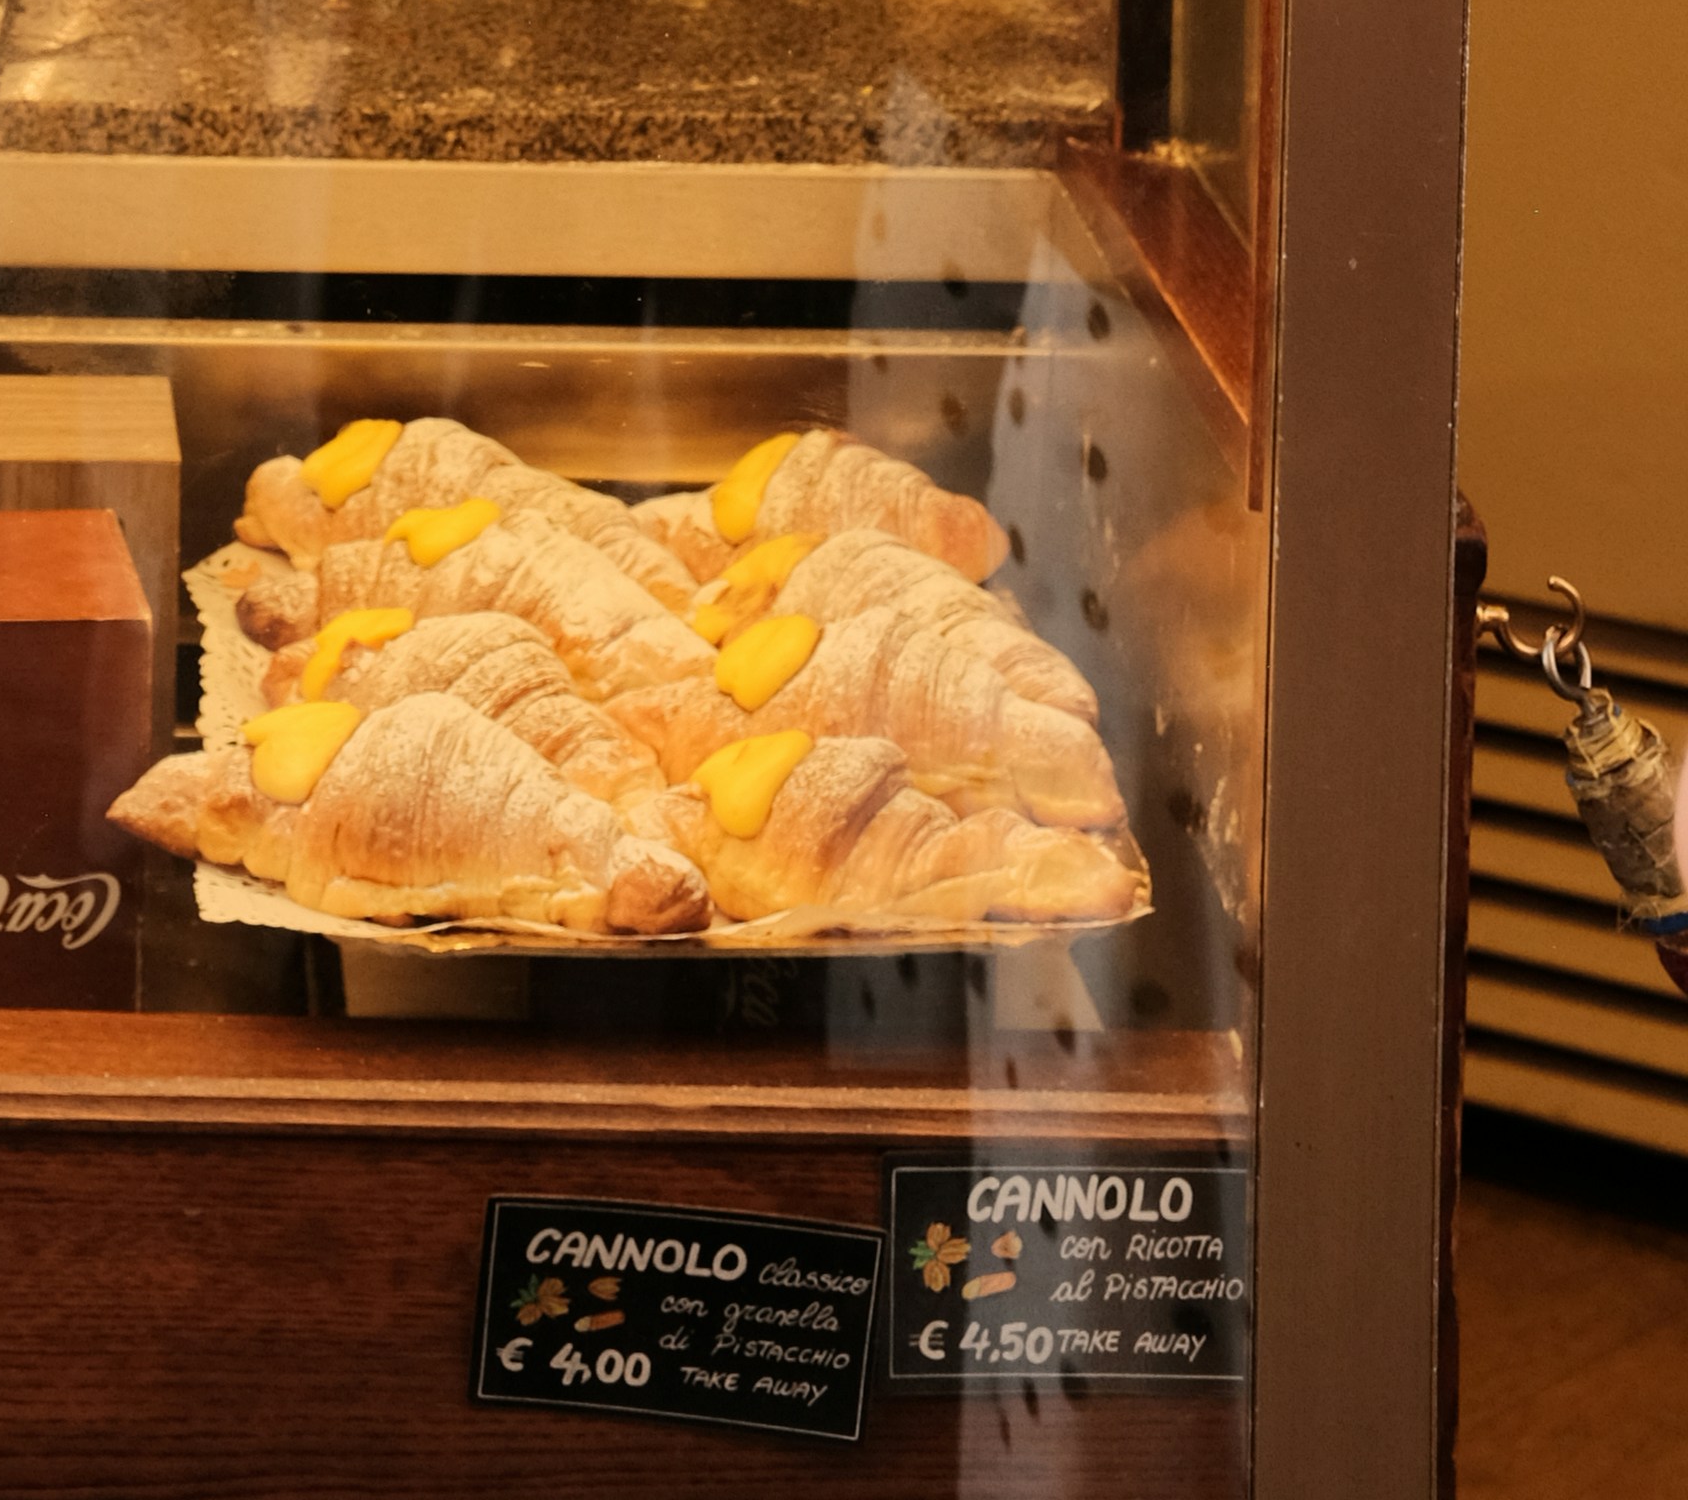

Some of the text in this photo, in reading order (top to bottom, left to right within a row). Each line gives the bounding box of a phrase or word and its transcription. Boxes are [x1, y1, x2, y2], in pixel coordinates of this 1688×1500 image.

[967, 1173, 1193, 1224] CANNOLO
[526, 1227, 872, 1296] CANNOLO classico
[1059, 1234, 1112, 1261] con
[1049, 1268, 1095, 1303] al
[660, 1295, 839, 1340] con granella
[658, 1326, 689, 1351] di
[1056, 1328, 1121, 1354] TAKE
[1133, 1331, 1206, 1362] AWAY
[680, 1366, 828, 1407] TAKE AWAY
